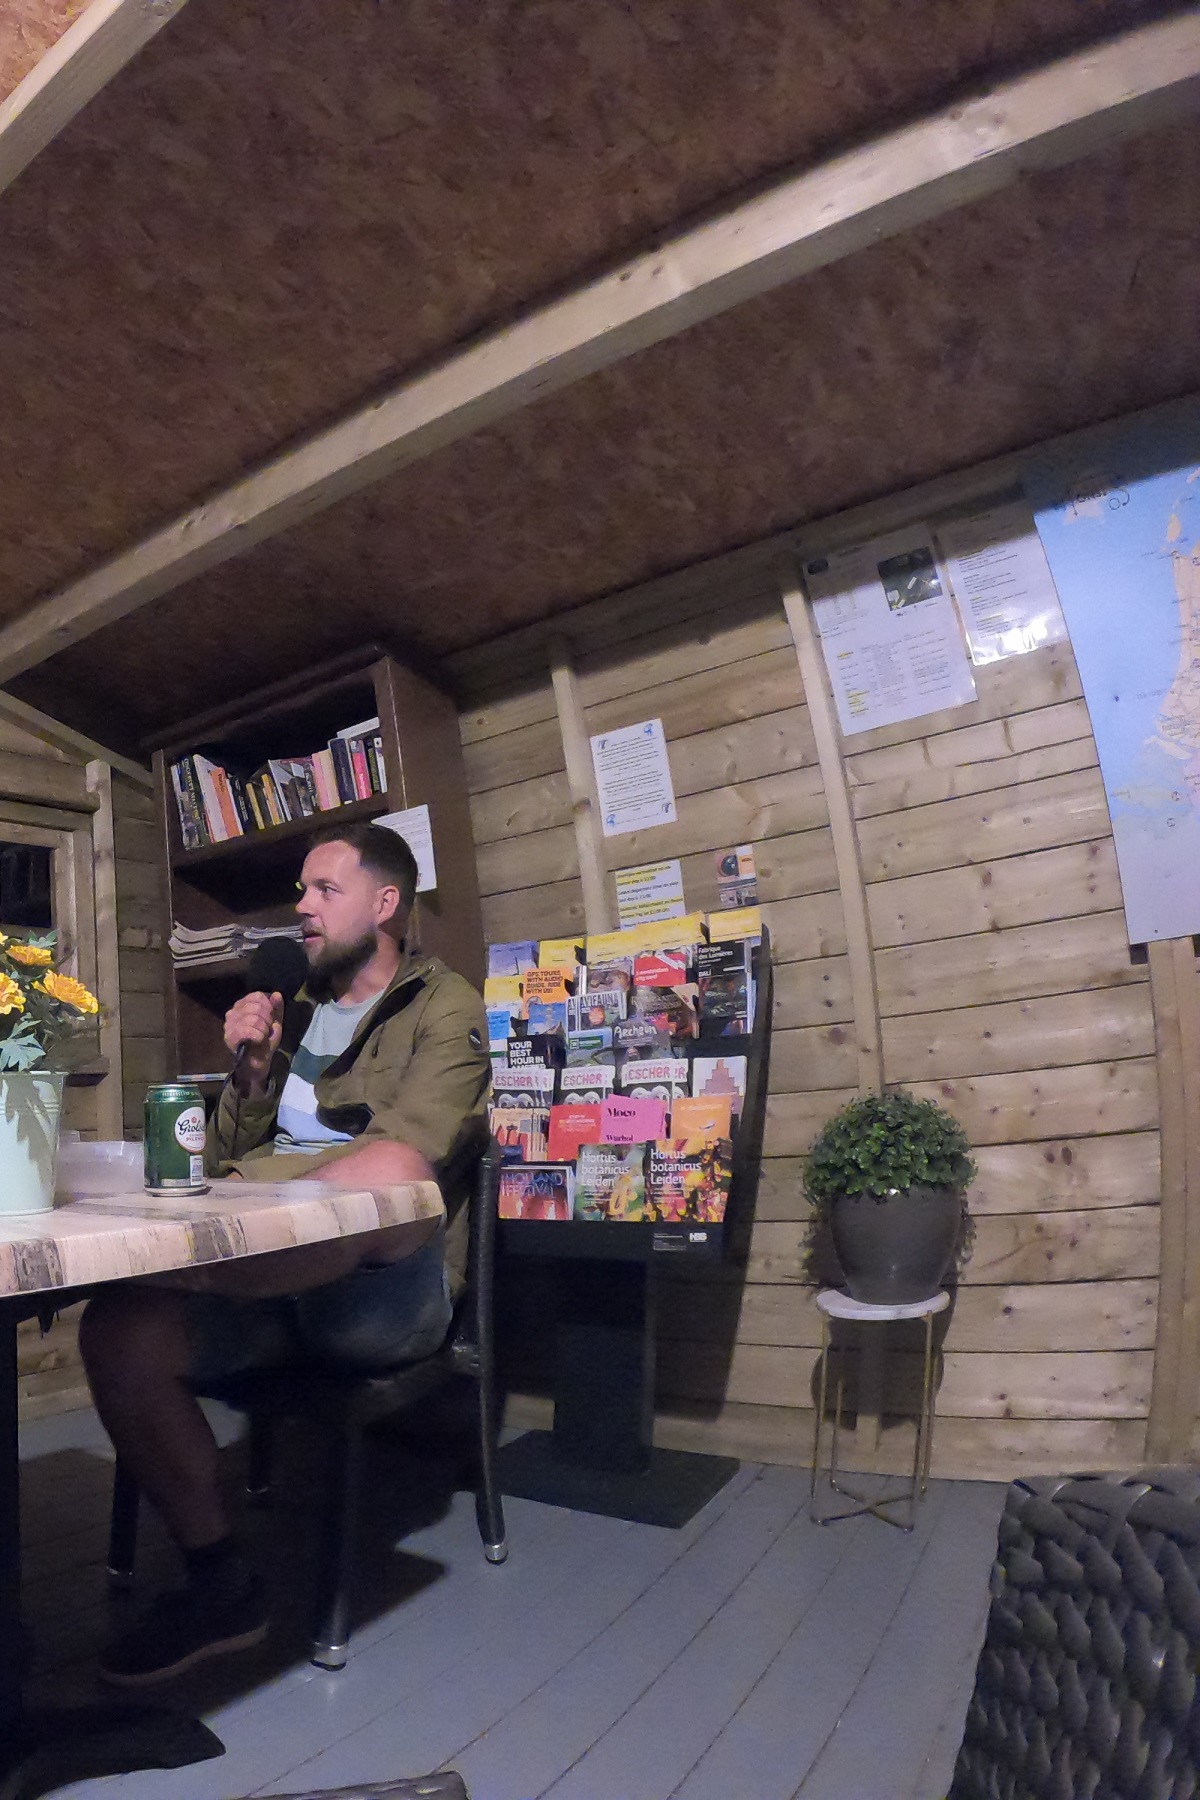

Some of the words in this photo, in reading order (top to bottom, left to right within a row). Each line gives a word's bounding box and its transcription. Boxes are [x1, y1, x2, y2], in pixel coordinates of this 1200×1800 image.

[509, 1040, 532, 1050] YOUR
[510, 1049, 532, 1058] BEST
[510, 1056, 536, 1065] HOUR
[582, 1152, 617, 1162] Hortus
[650, 1148, 686, 1160] Hortus
[582, 1164, 630, 1175] botanicus
[650, 1160, 702, 1172] botanicus
[582, 1176, 615, 1186] Leiden
[650, 1173, 686, 1185] Leiden
